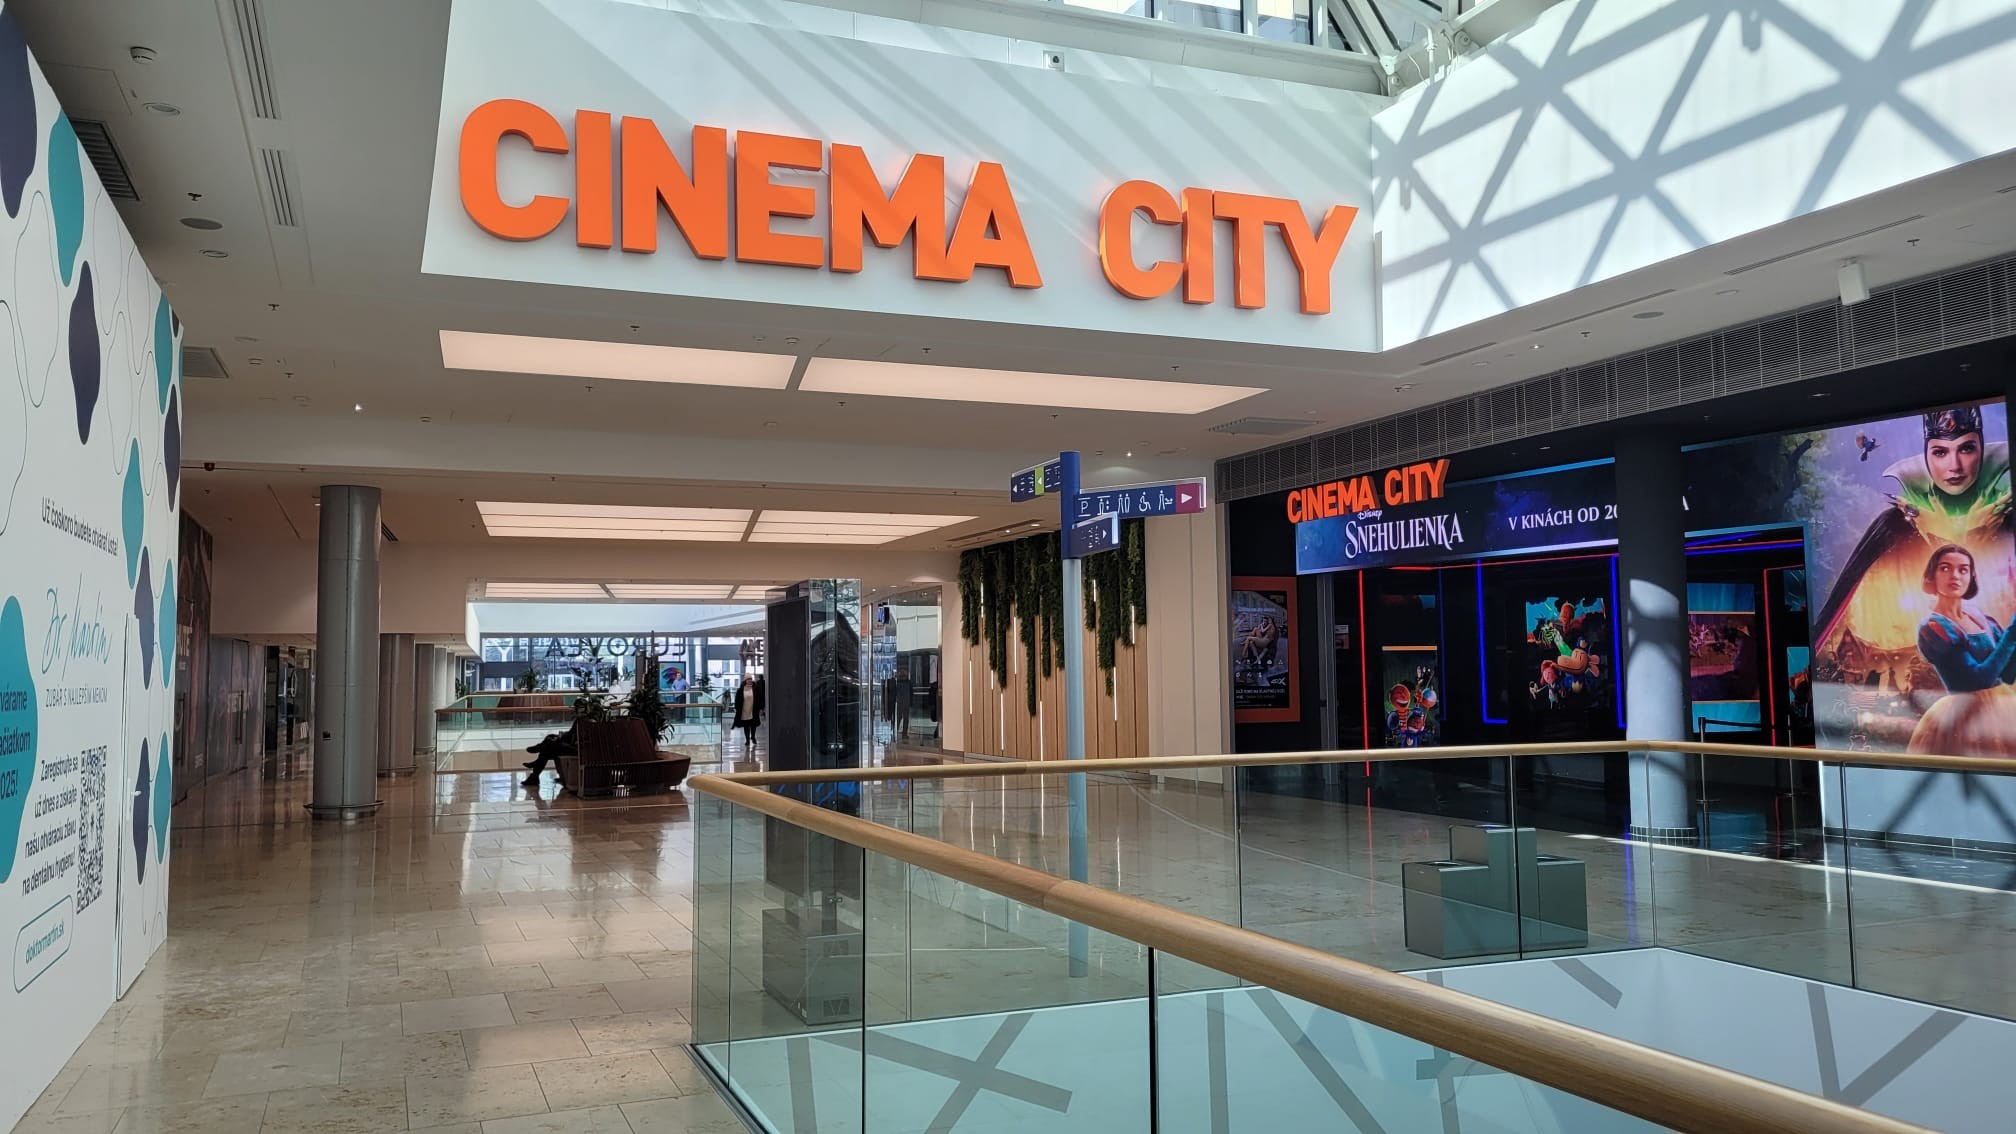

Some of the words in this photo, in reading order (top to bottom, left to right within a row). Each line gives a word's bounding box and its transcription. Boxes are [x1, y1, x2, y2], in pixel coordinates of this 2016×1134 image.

[458, 98, 1044, 289] CINEMA
[1099, 179, 1359, 316] CITY
[1287, 476, 1379, 523] CINEMA
[1384, 459, 1449, 506] CITY
[51, 501, 73, 535] čoskoro
[74, 514, 91, 544] budete
[1357, 509, 1382, 520] Disney
[1508, 516, 1517, 531] V
[1521, 508, 1572, 529] KINÁCH
[1577, 506, 1600, 523] OD
[1345, 512, 1464, 558] SNEHULIENKA
[72, 756, 78, 771] sa
[42, 791, 55, 813] dnes
[25, 832, 40, 859] našu
[22, 877, 31, 896] na
[31, 860, 54, 890] dentálnu
[25, 919, 65, 964] doktormartin.sk
